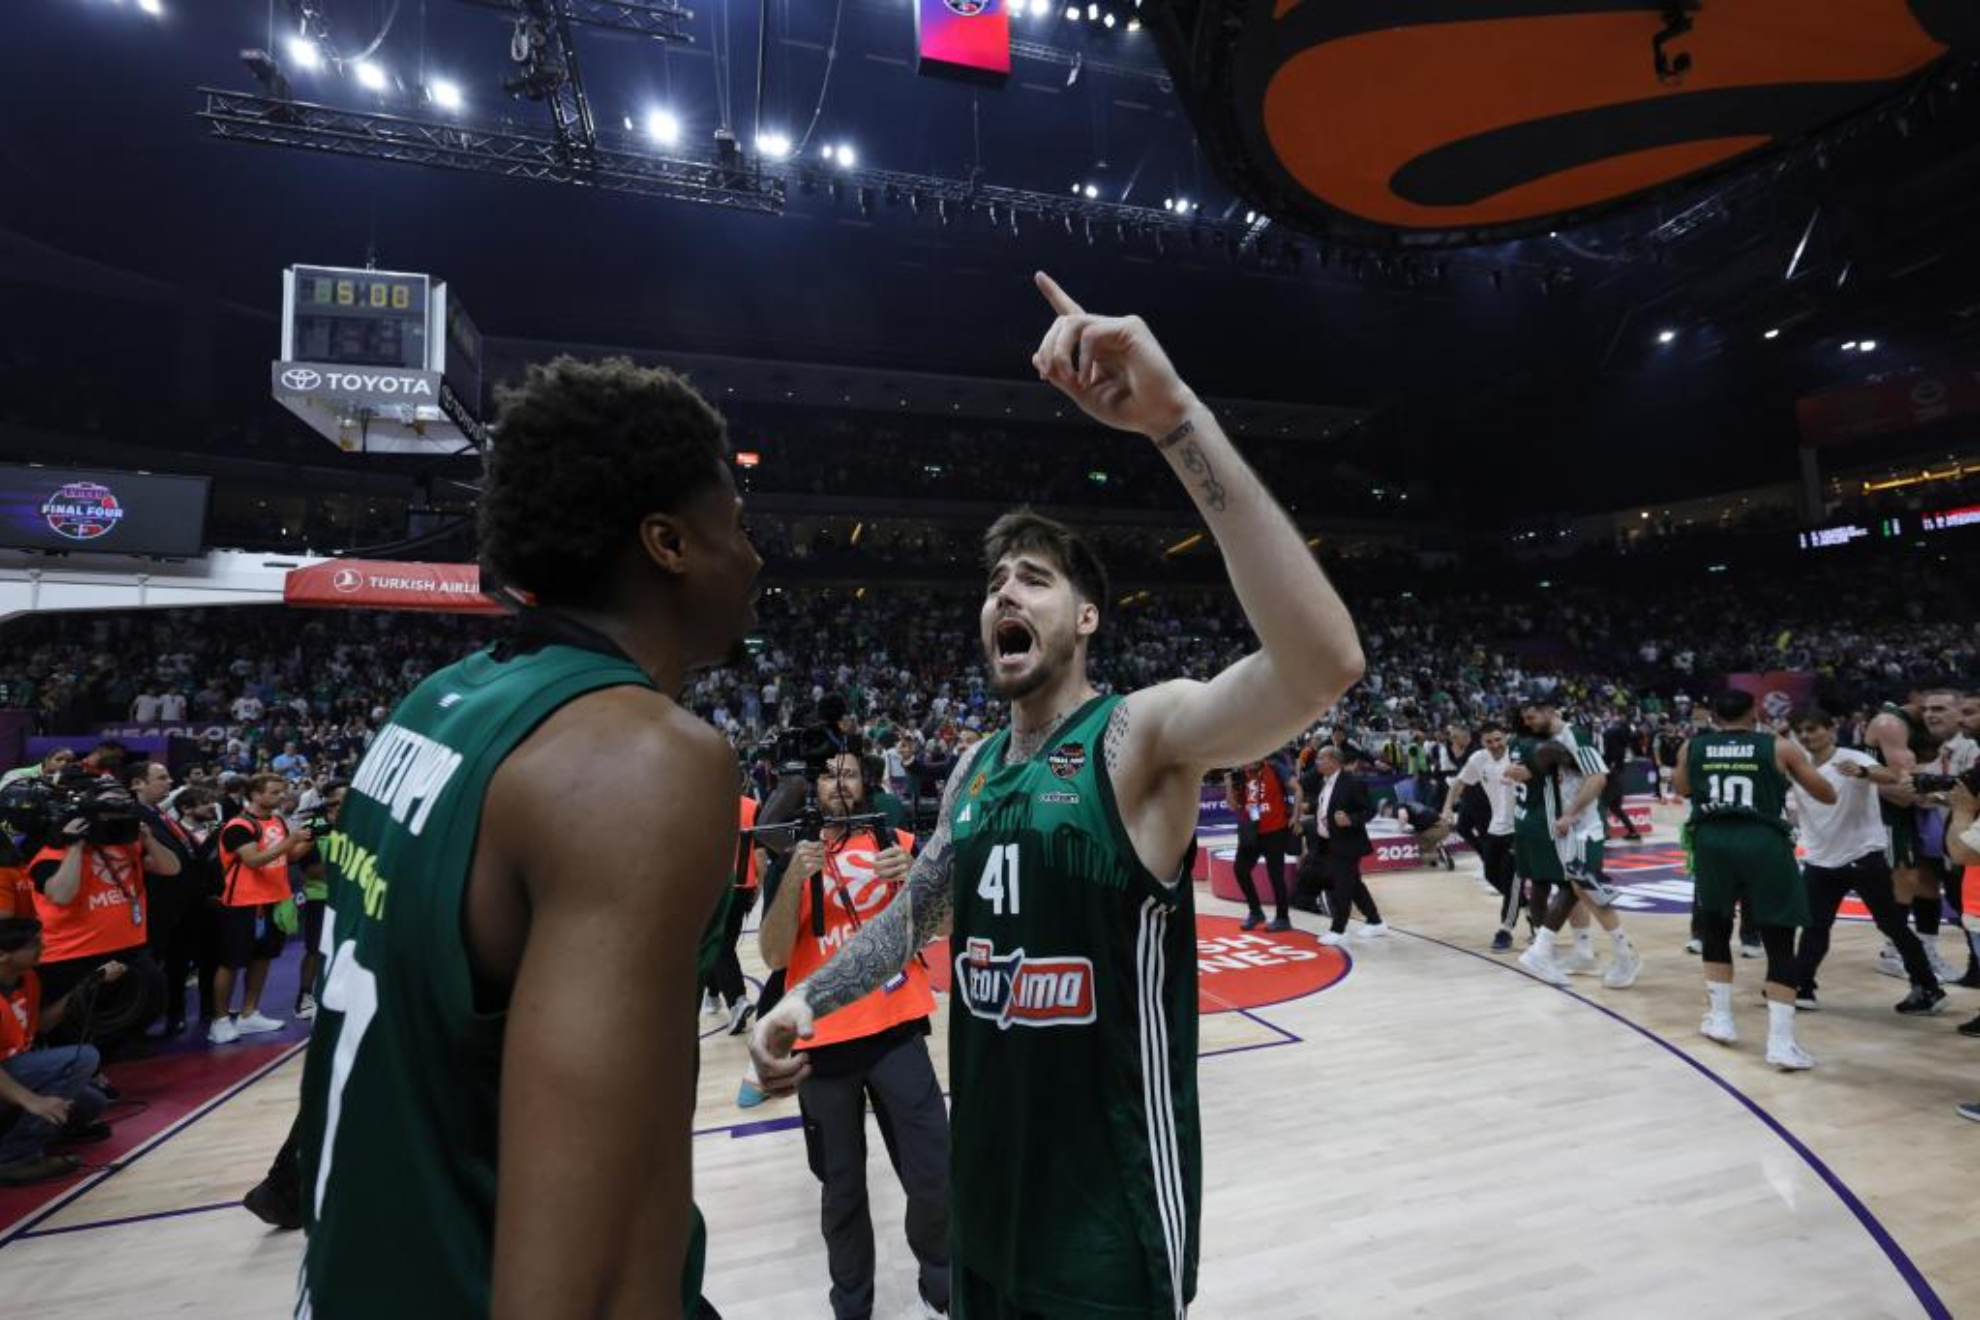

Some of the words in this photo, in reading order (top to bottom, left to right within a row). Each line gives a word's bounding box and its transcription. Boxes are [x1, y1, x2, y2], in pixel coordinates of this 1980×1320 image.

[326, 372, 432, 396] TOYOTA
[41, 504, 83, 516] FINAL
[85, 506, 124, 518] FOUR
[369, 575, 435, 592] TURKISH
[439, 582, 480, 593] AIRLI
[1708, 774, 1754, 807] 10
[977, 842, 1021, 915] 41
